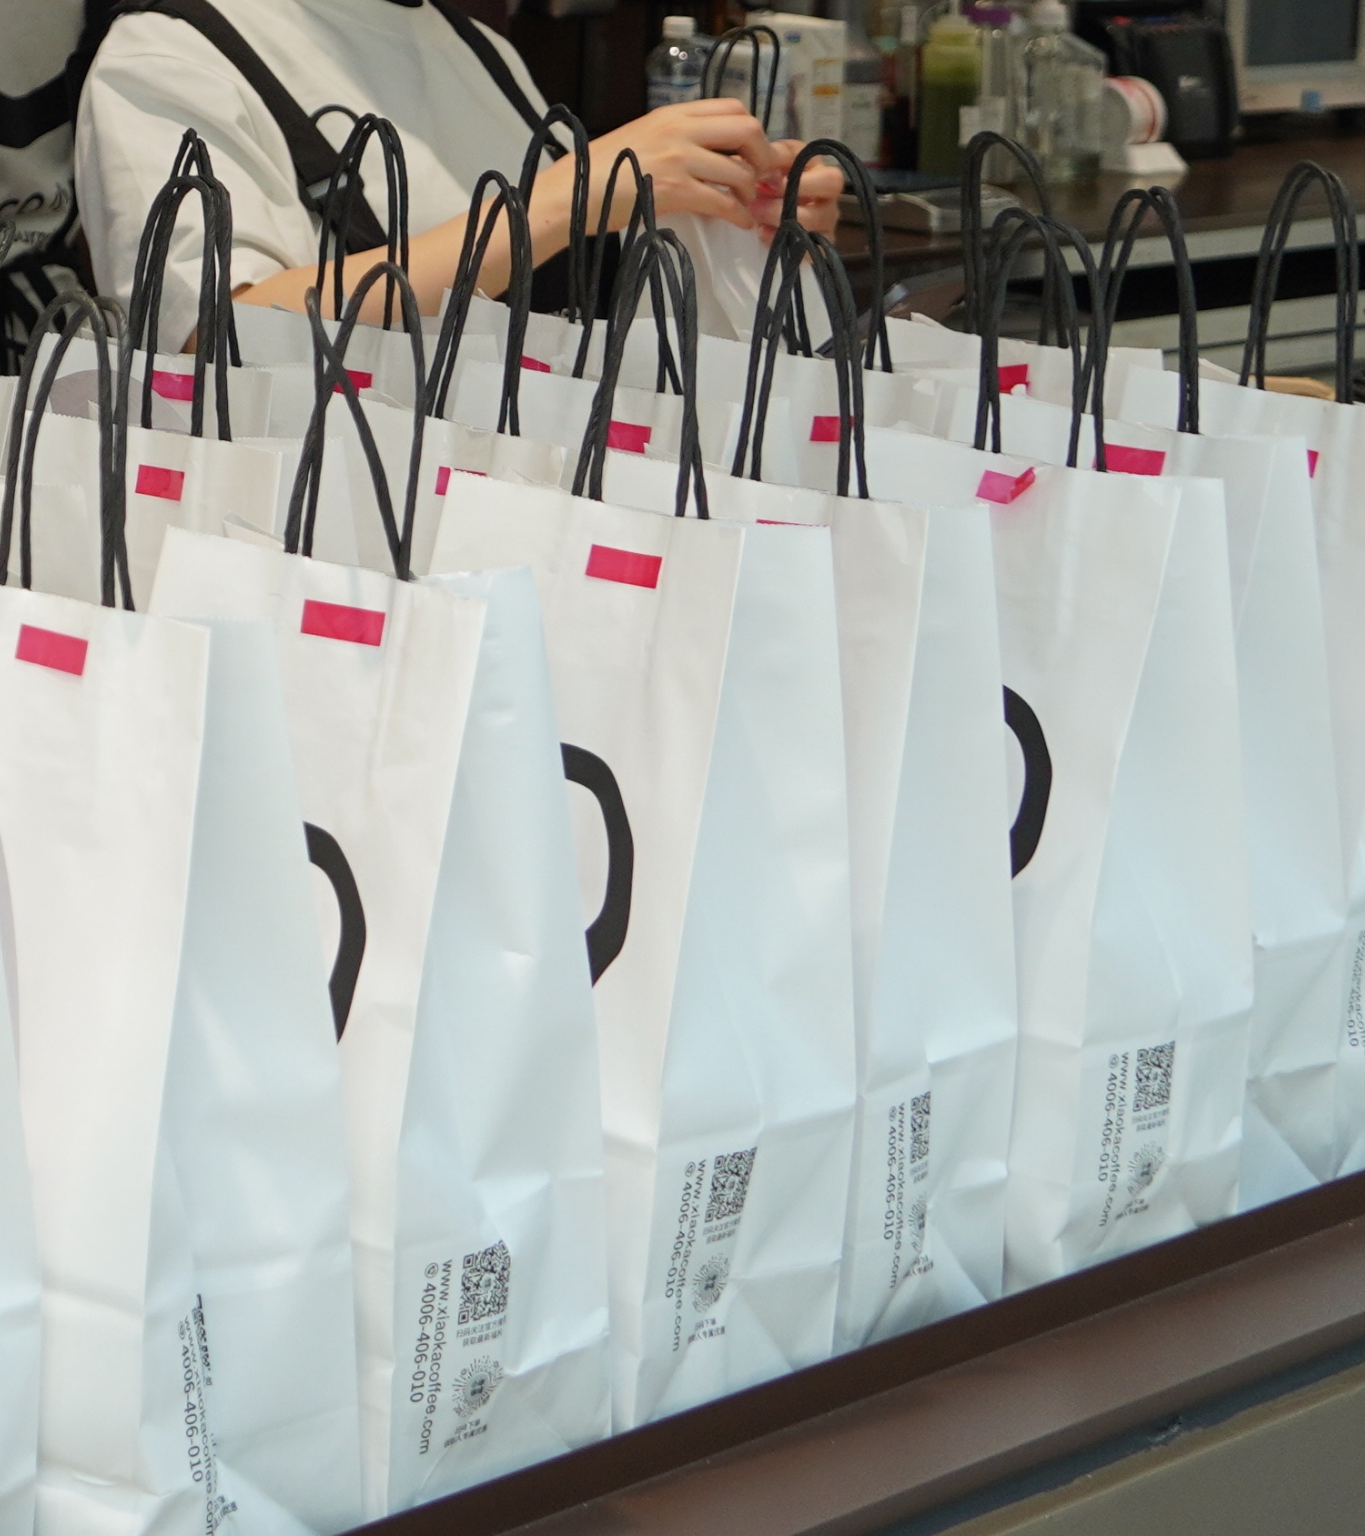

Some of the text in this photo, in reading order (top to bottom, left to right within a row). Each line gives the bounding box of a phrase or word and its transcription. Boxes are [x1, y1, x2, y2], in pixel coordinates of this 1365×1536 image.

[883, 1125, 897, 1240] 4006-406-010
[1098, 1072, 1118, 1182] 4006-406-010
[665, 1181, 692, 1298] 4006-406-010
[410, 1282, 436, 1402] 4006-406-010
[419, 1259, 453, 1455] www.xiaokacoffee.com
[180, 1344, 204, 1482] 4006-406-010
